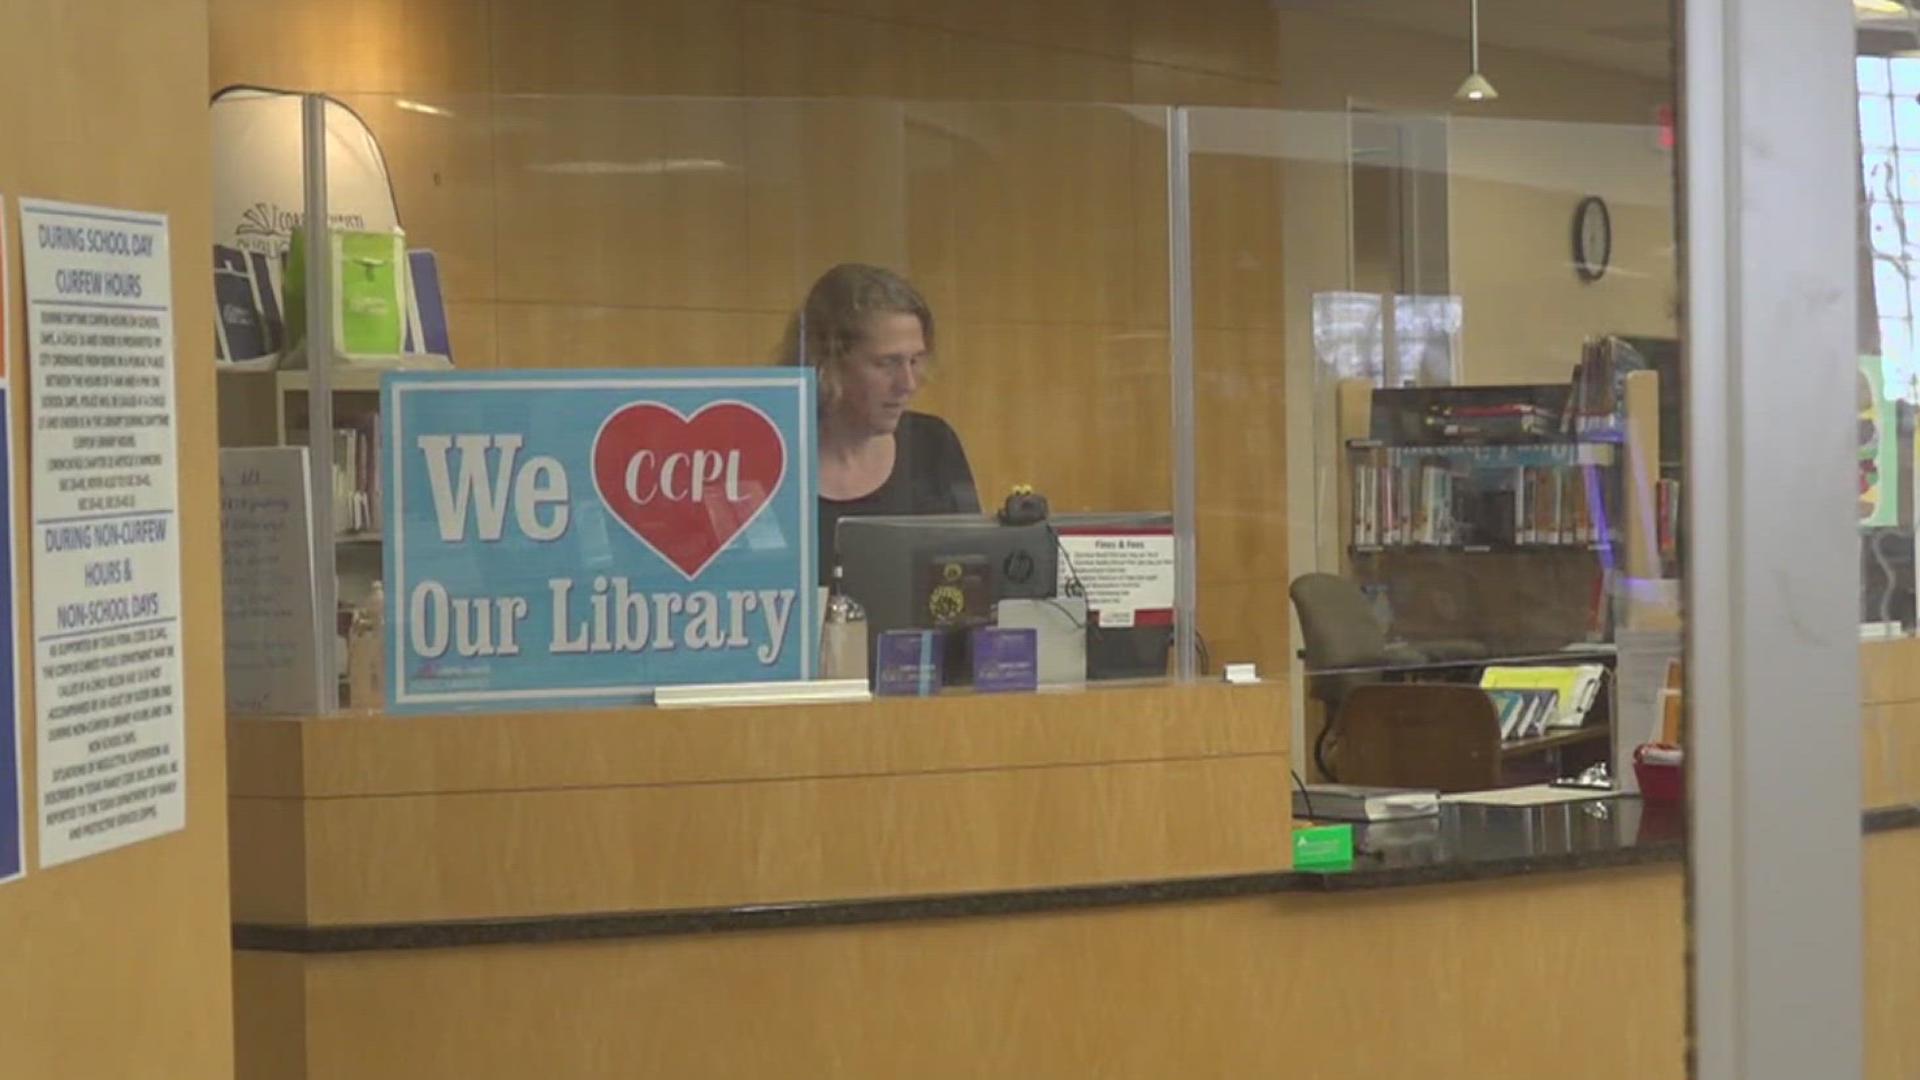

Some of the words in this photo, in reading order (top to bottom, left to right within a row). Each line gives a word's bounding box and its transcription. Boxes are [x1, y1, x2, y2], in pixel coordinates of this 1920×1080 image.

[39, 224, 85, 252] DURING
[87, 228, 130, 256] SCHOOL
[131, 233, 153, 258] DAY
[56, 269, 102, 294] CURFEW
[104, 272, 142, 298] HOURS
[417, 434, 569, 543] We
[625, 448, 752, 504] CCPL
[45, 526, 92, 553] DURING
[94, 519, 167, 547] NON-CURFEW
[85, 560, 121, 587] HOURS
[123, 558, 132, 582] &
[57, 597, 130, 629] NON-SCHOOL
[132, 592, 159, 618] DAYS
[410, 581, 527, 658] Our
[549, 574, 796, 665] Library
